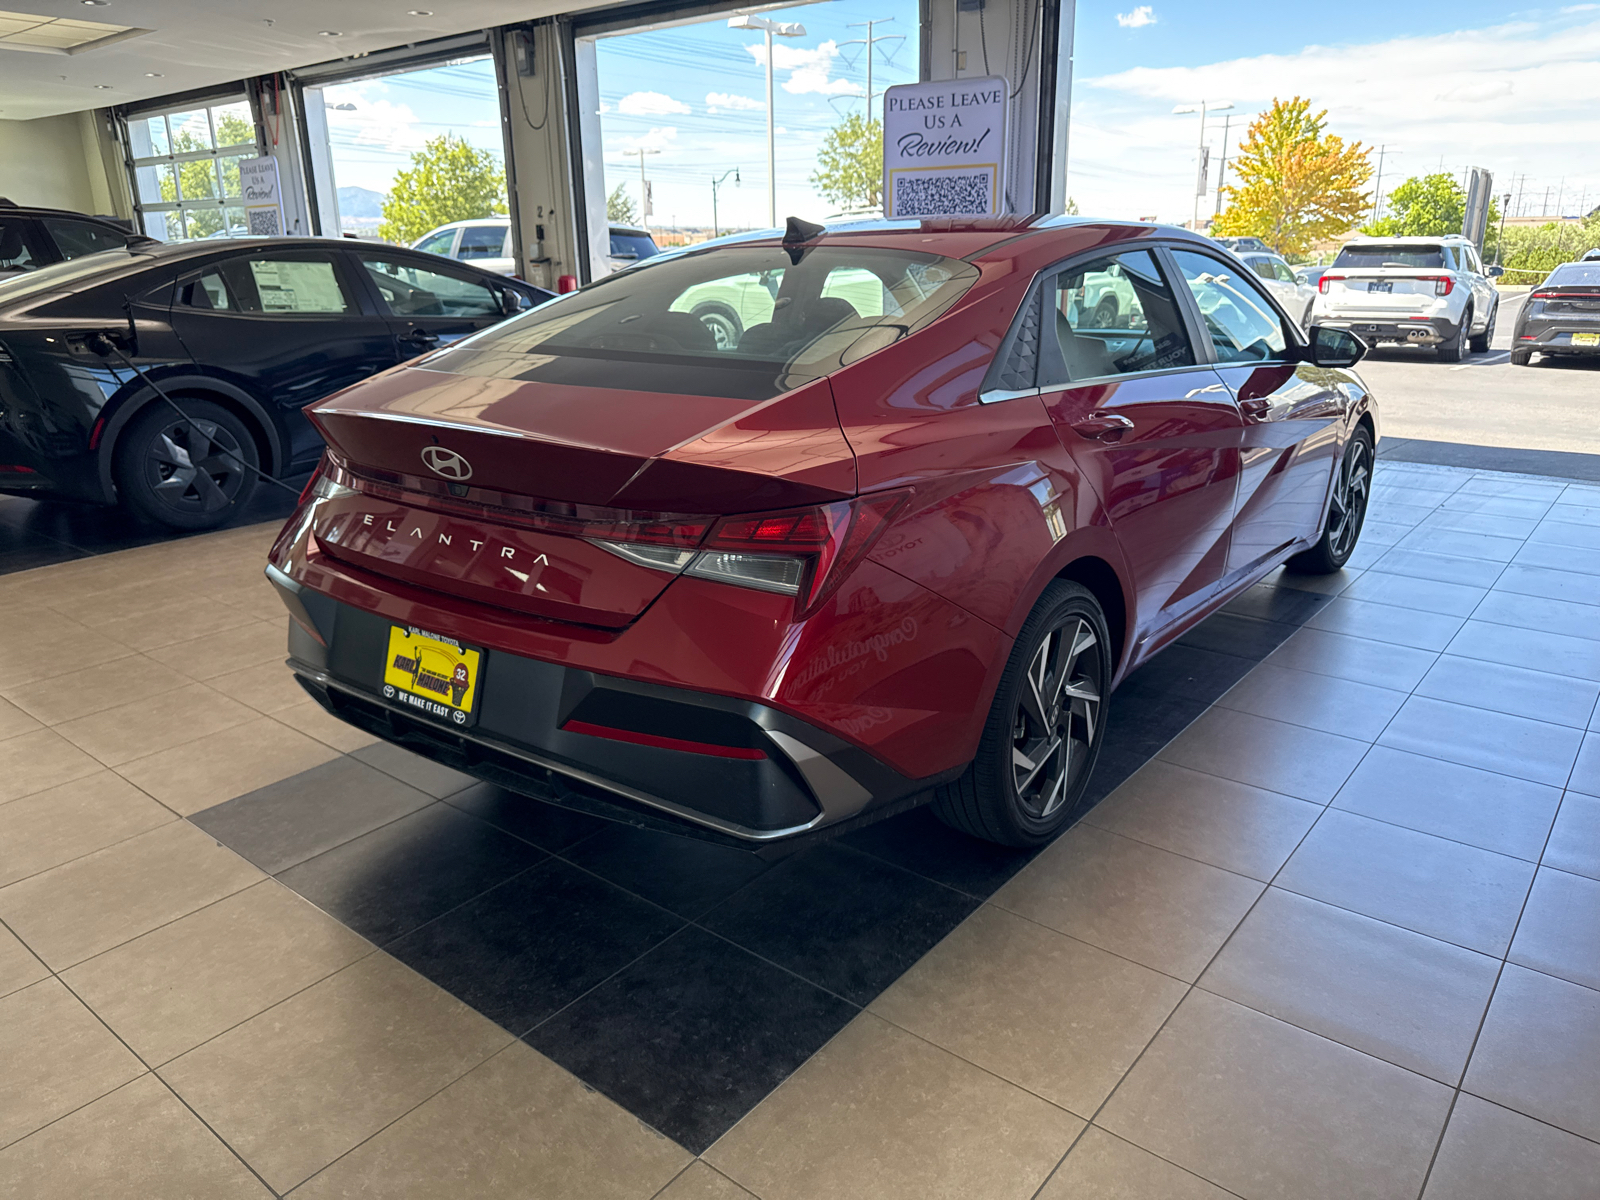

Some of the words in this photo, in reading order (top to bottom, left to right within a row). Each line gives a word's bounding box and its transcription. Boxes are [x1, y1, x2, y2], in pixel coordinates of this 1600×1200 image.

[889, 95, 944, 112] PLEASE
[951, 90, 1001, 107] LEAVE
[924, 115, 945, 129] US
[950, 113, 962, 127] A
[897, 127, 991, 158] Review!
[240, 165, 257, 175] PLEASE
[537, 205, 543, 219] 2
[363, 514, 549, 566] ELANTRA
[416, 672, 451, 696] MALONE
[455, 668, 466, 681] 32
[398, 691, 408, 702] WE
[408, 694, 425, 709] MAKE
[425, 701, 432, 711] IT
[432, 704, 450, 717] EASY
